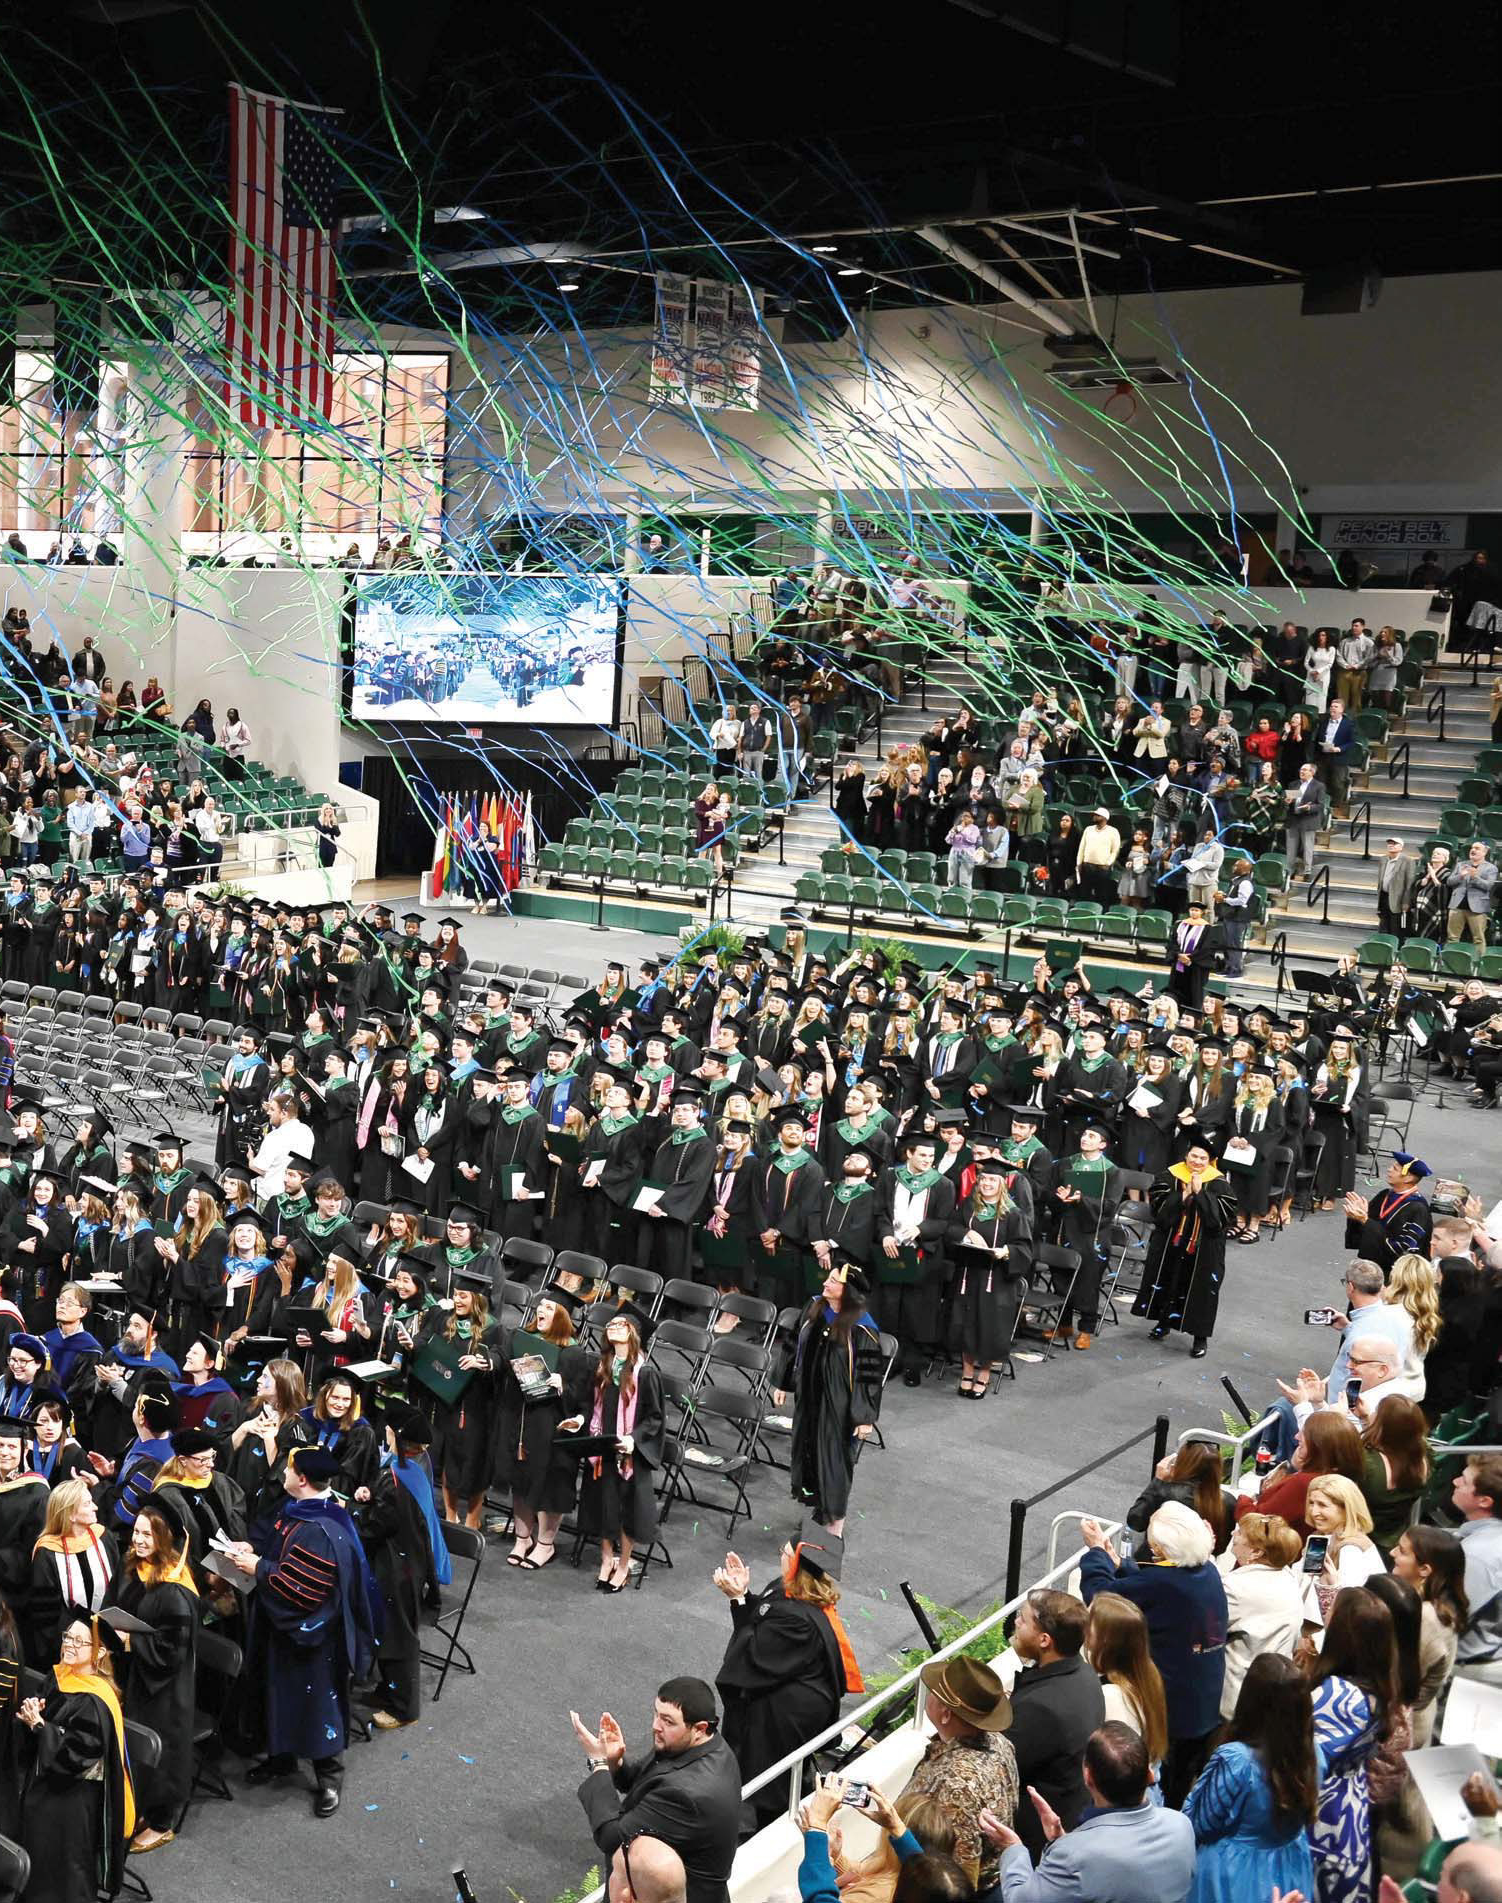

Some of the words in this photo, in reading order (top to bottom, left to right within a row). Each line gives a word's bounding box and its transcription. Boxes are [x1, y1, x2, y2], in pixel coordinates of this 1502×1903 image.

[1339, 520, 1404, 532] PEACH
[1405, 520, 1451, 532] BELT
[1334, 532, 1403, 544] HONOR
[1403, 532, 1450, 544] ROLL
